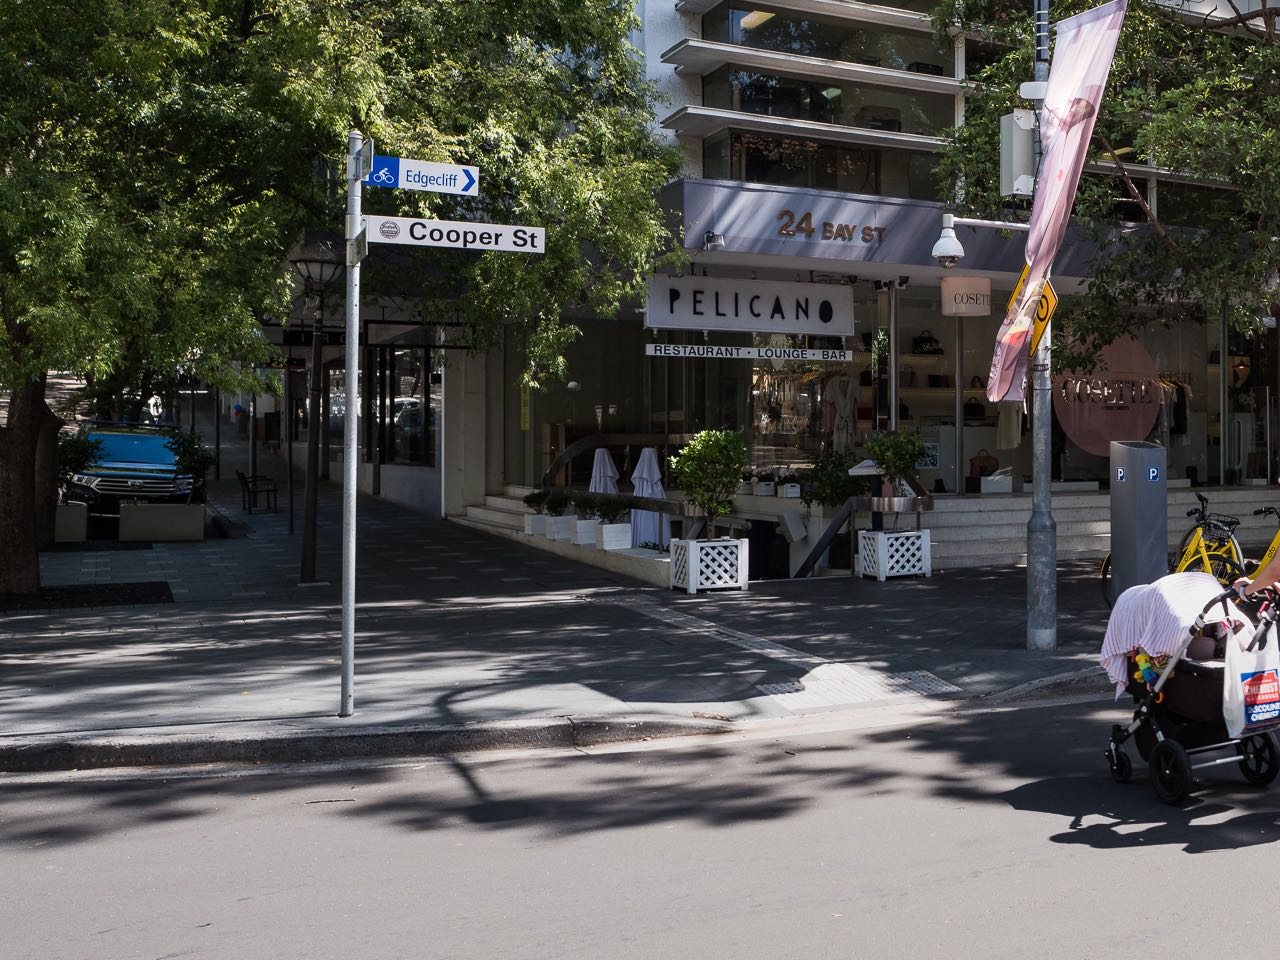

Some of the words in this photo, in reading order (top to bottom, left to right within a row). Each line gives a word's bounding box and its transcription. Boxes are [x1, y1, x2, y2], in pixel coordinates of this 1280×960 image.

[406, 170, 458, 187] Edgecliff
[409, 221, 502, 247] Cooper
[512, 229, 538, 248] St
[776, 210, 815, 238] 24
[822, 222, 857, 241] BAY
[861, 225, 886, 243] ST
[669, 288, 834, 323] PELICANO
[654, 345, 741, 357] RESTAURANT
[757, 348, 808, 359] LOUNGE
[822, 350, 847, 360] BAR
[1062, 378, 1152, 404] COSETTE
[1117, 468, 1124, 479] P
[1150, 468, 1157, 479] P
[1184, 550, 1192, 562] ofo
[1268, 546, 1276, 558] ofo
